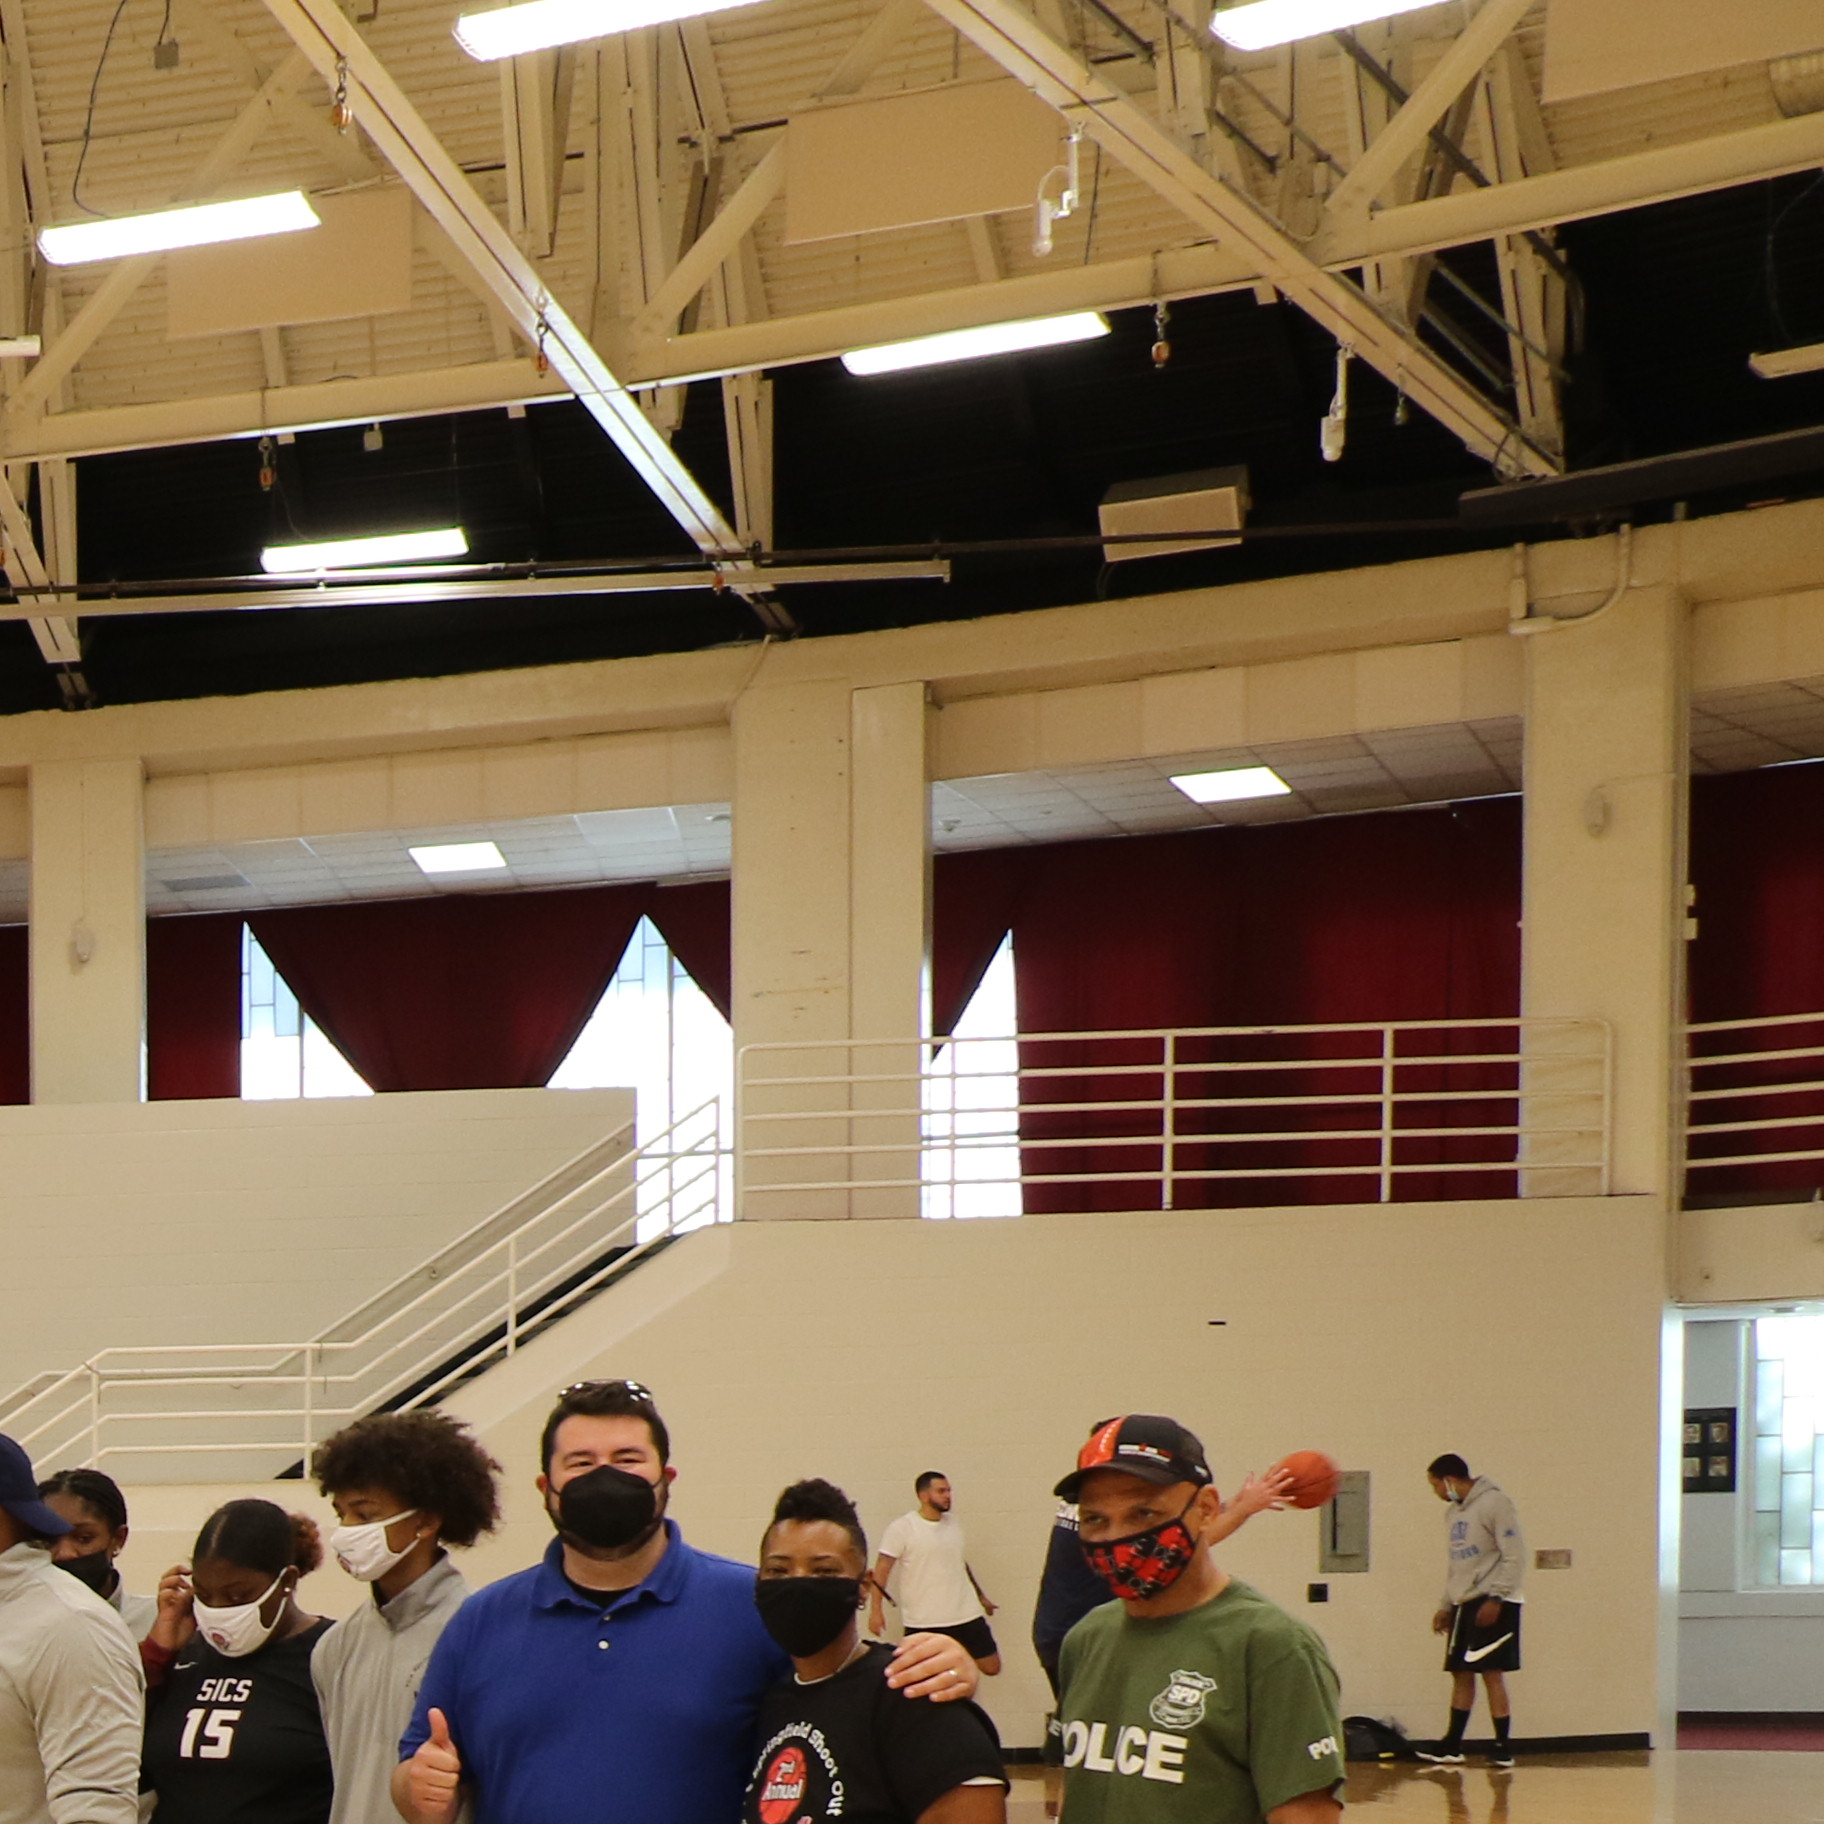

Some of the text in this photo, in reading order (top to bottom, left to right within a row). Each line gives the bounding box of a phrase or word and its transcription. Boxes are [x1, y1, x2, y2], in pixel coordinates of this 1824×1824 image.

[196, 1677, 253, 1702] SICS
[1167, 1684, 1202, 1707] SPD
[180, 1708, 242, 1759] 15
[761, 1778, 803, 1801] Annual
